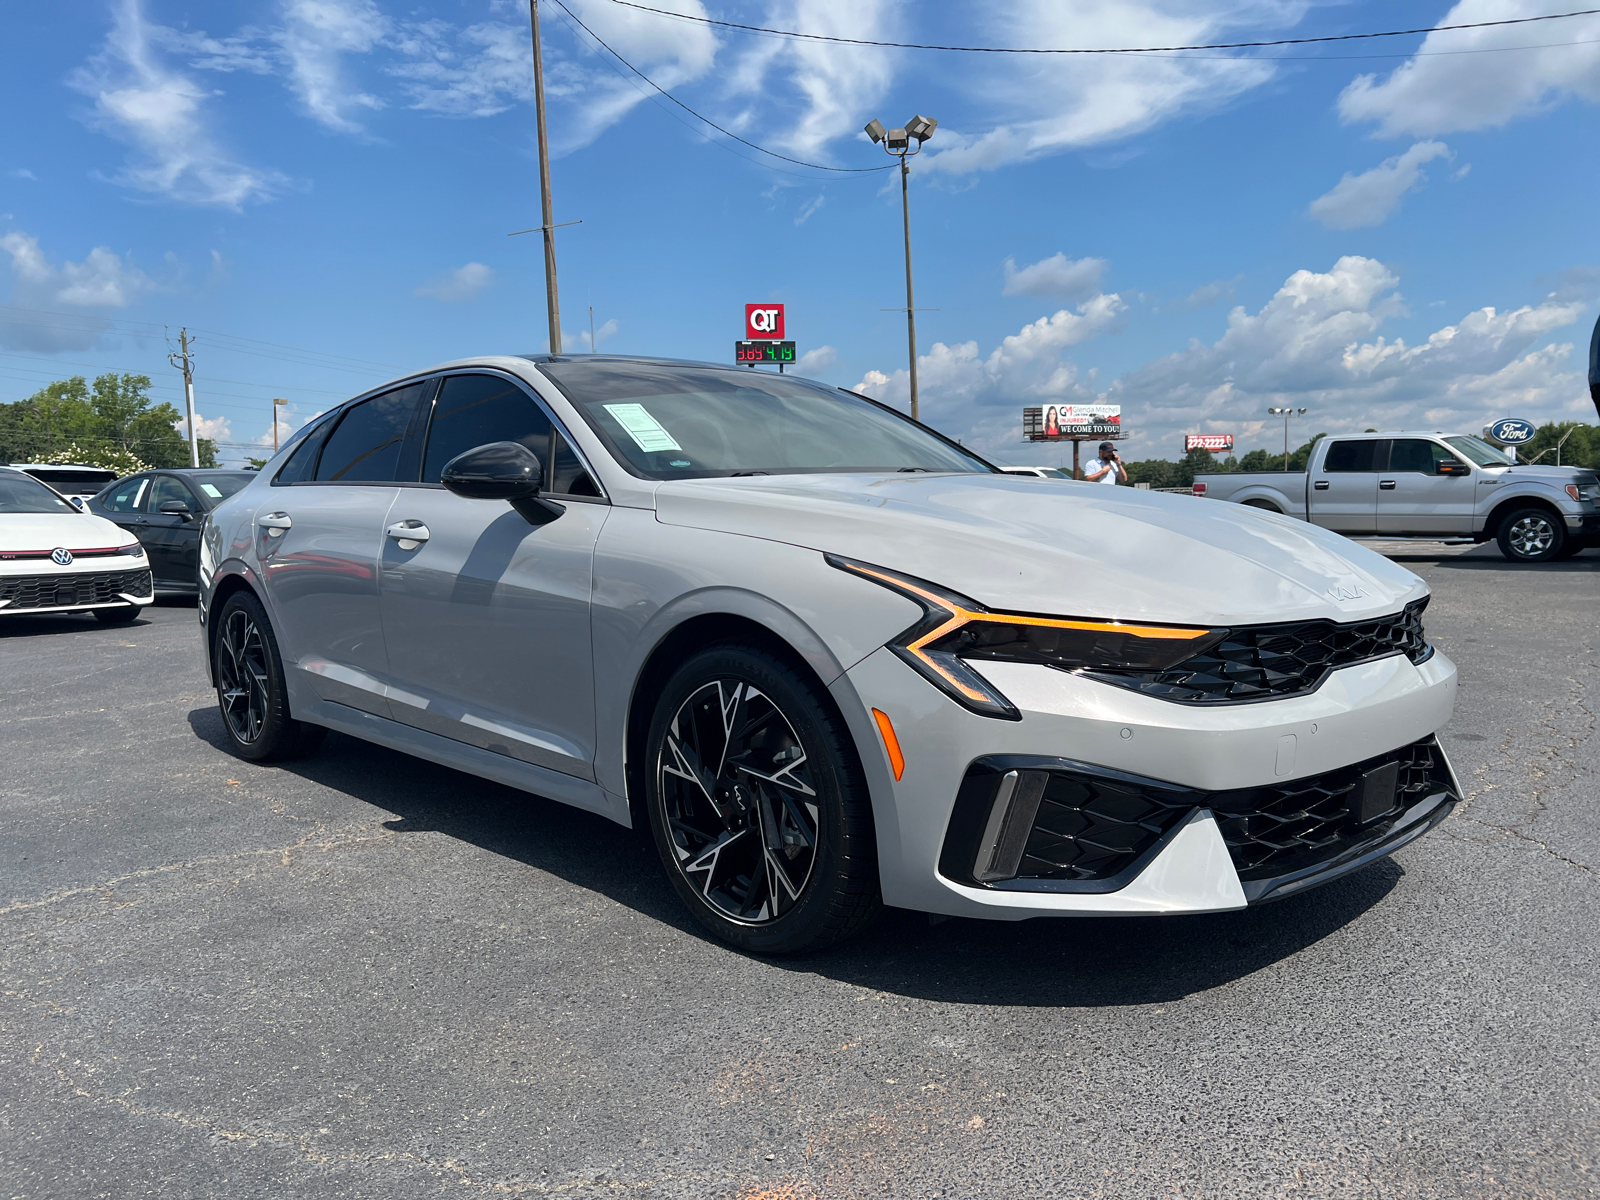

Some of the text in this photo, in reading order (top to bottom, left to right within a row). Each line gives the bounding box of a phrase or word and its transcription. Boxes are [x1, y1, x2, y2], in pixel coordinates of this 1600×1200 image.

[750, 309, 780, 334] QT
[1060, 406, 1119, 417] GM Glenda Mitchell
[1061, 425, 1120, 433] WE COME TO YOU!
[1500, 423, 1528, 439] Ford
